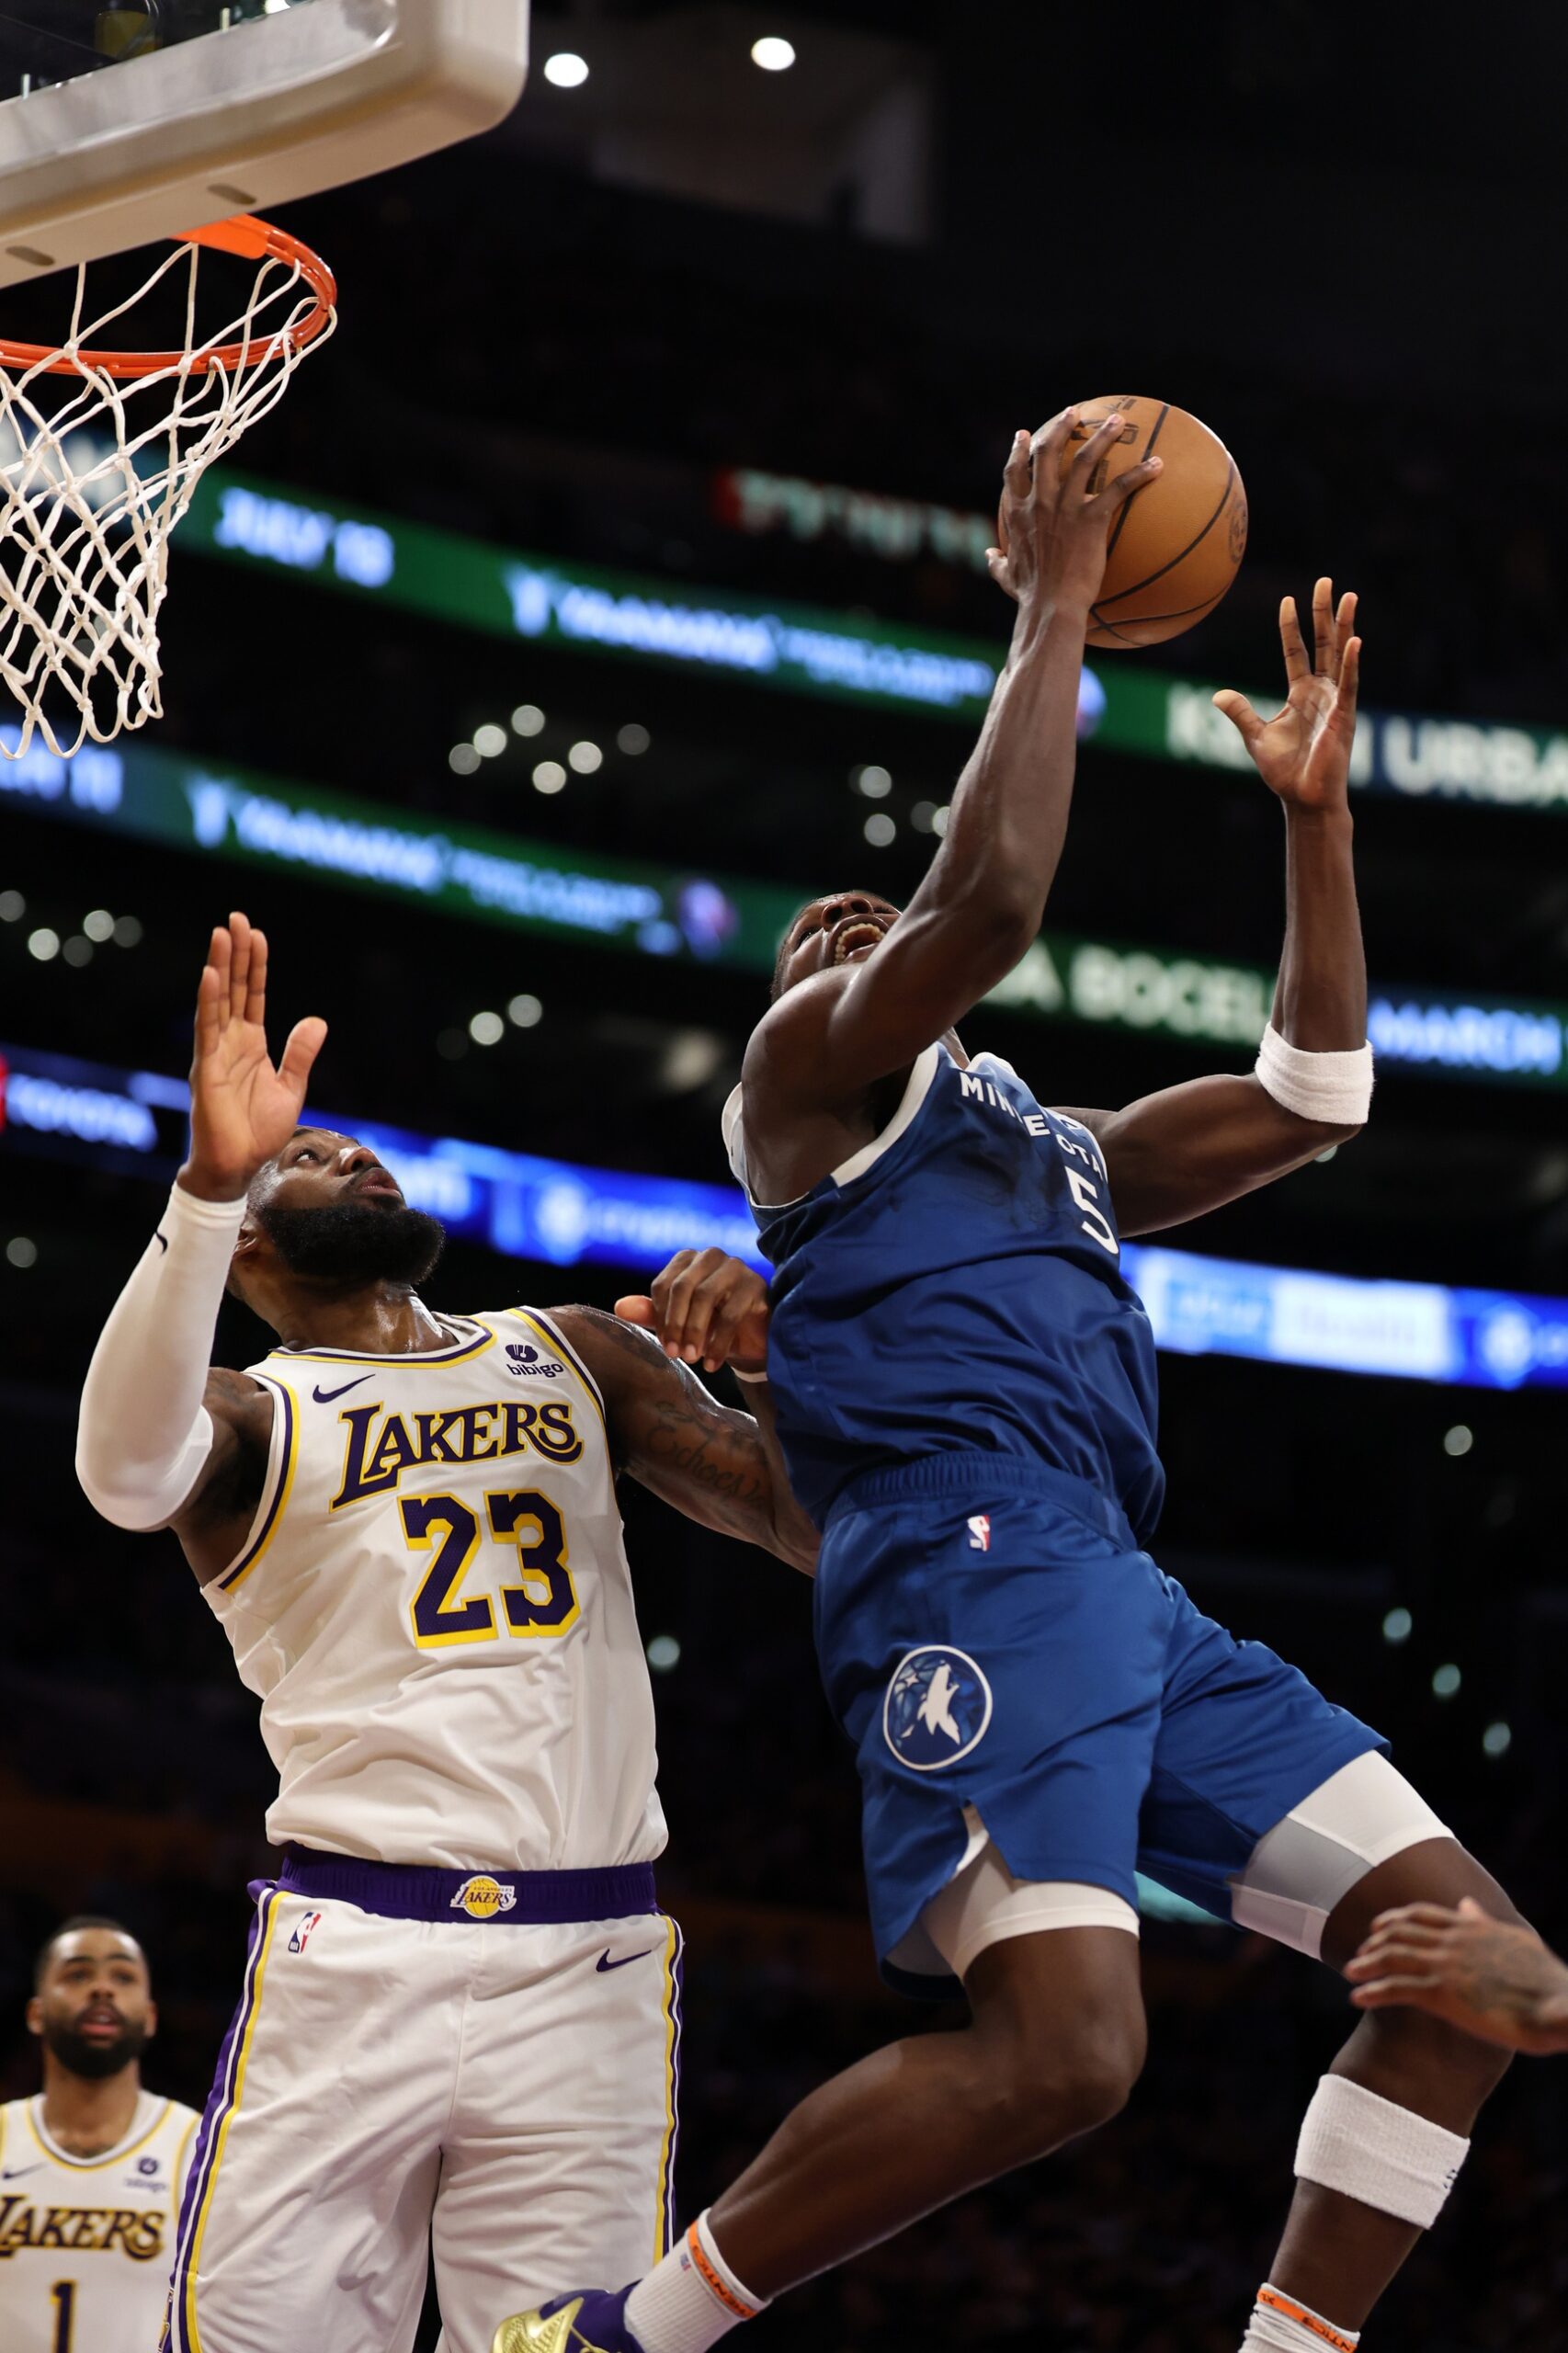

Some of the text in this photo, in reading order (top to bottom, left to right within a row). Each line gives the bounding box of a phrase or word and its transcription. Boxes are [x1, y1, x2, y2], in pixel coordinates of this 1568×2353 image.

[1064, 1166, 1119, 1255] 5
[506, 1363, 564, 1379] bibigo
[329, 1400, 585, 1515] LAKERS
[396, 1487, 582, 1649] 23
[456, 1886, 513, 1909] LAKERS
[50, 2279, 78, 2353] 1
